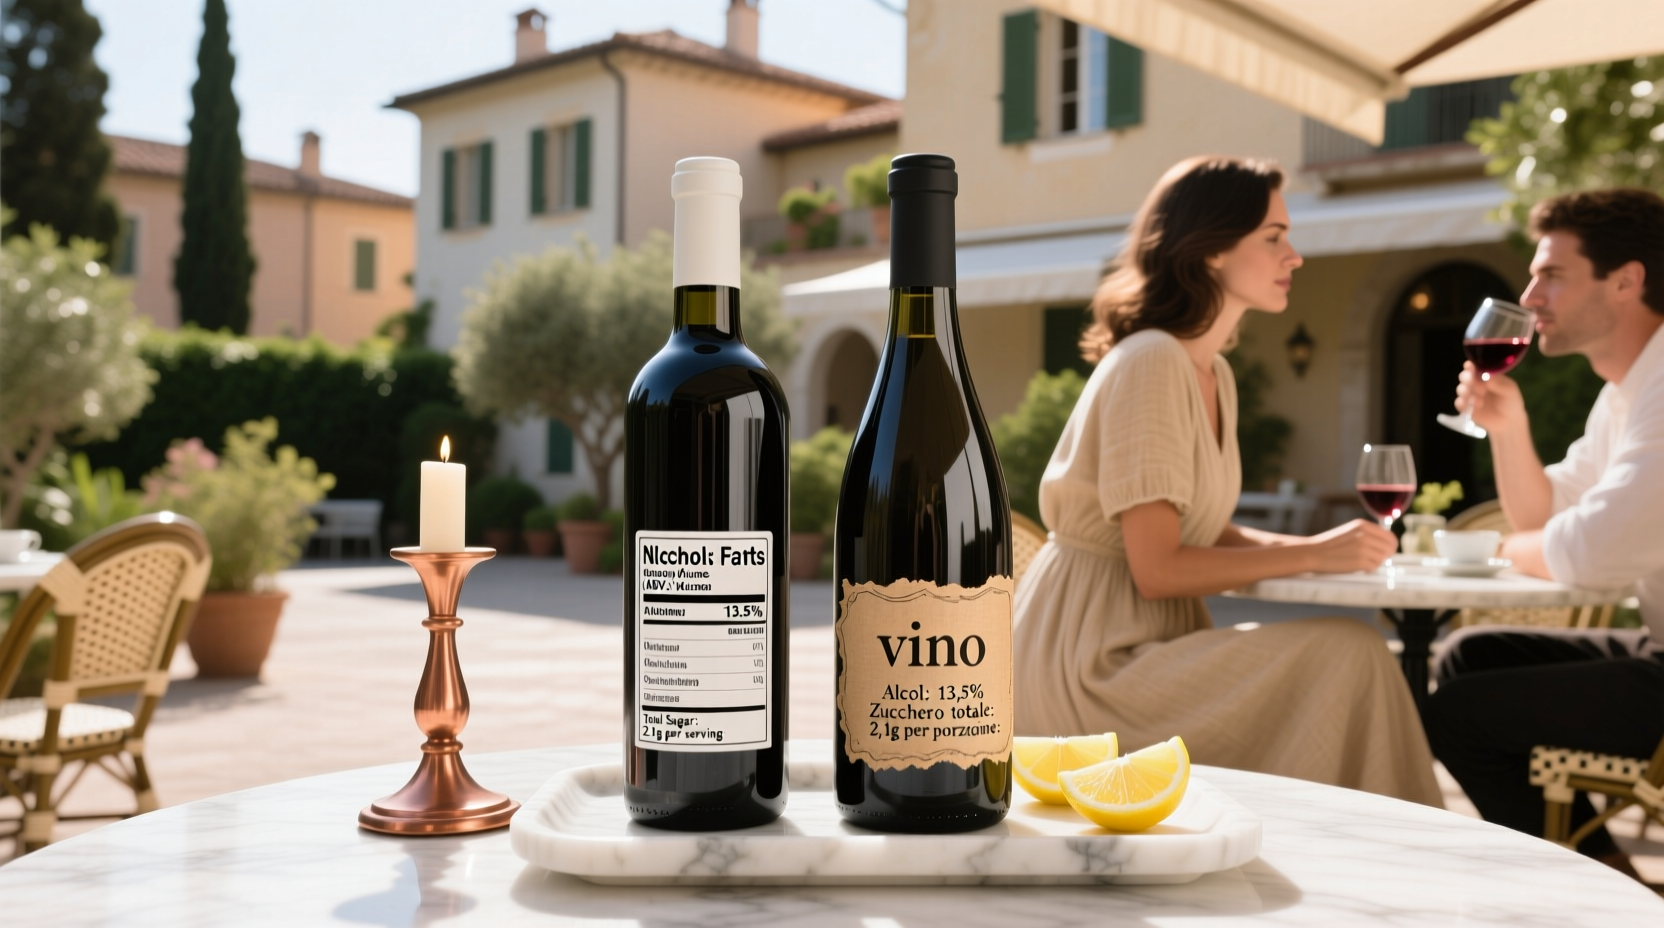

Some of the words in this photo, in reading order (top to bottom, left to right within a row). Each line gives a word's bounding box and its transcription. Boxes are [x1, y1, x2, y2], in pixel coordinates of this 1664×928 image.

[721, 546, 765, 566] Farts
[723, 605, 763, 618] 13.5%
[877, 621, 986, 667] vino
[882, 684, 929, 701] Alcol:
[938, 684, 984, 703] 13,5%
[869, 703, 944, 719] Zucchero
[951, 702, 994, 719] totale:
[685, 728, 723, 741] serving
[869, 722, 900, 741] 2,1g
[904, 726, 930, 741] per
